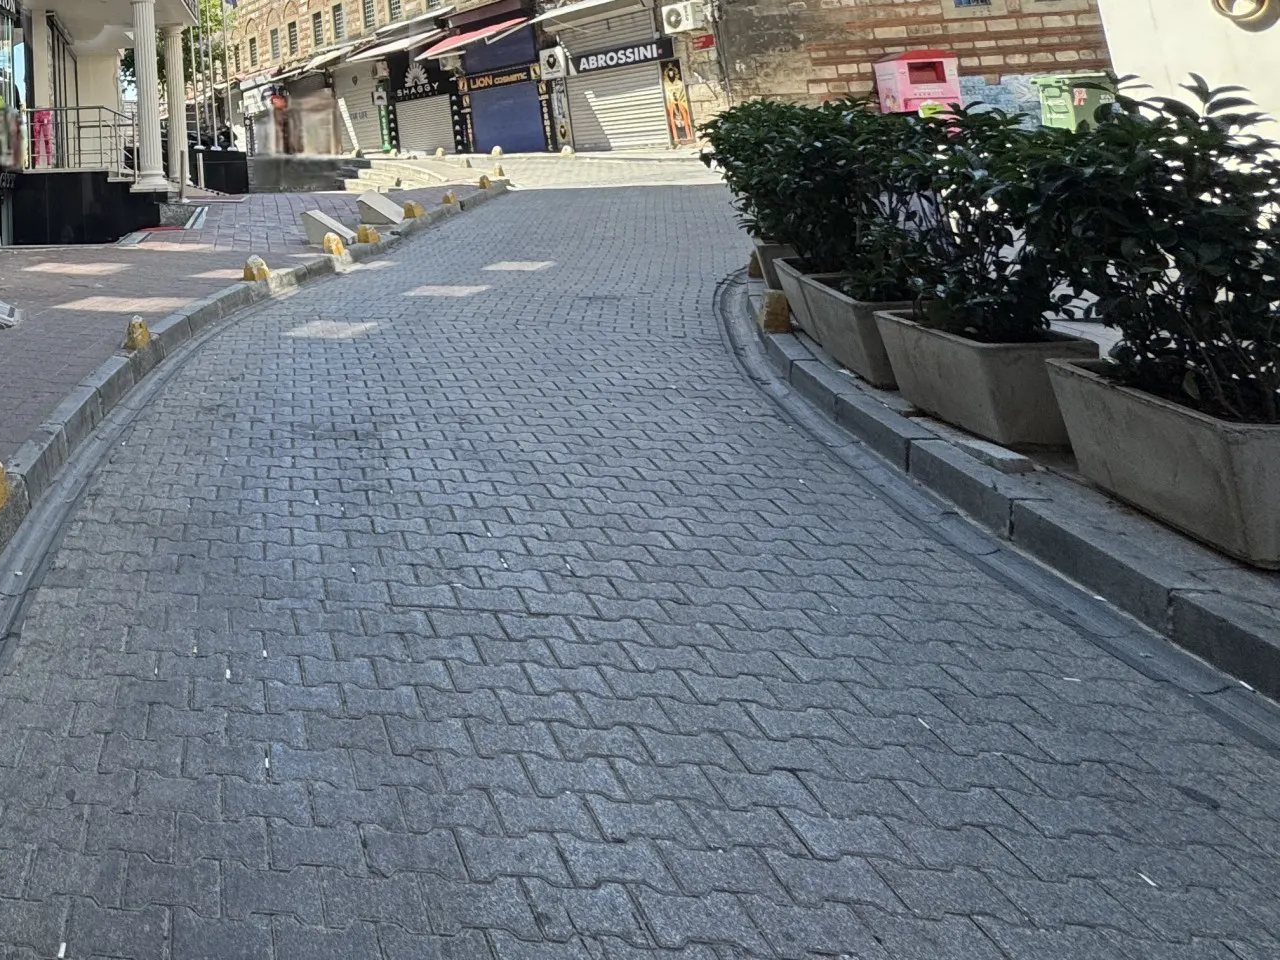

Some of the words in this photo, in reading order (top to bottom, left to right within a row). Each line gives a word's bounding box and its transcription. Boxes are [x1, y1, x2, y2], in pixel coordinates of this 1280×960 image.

[578, 44, 658, 72] ABROSSINI
[396, 81, 439, 97] SHAGGY
[470, 74, 493, 89] LION
